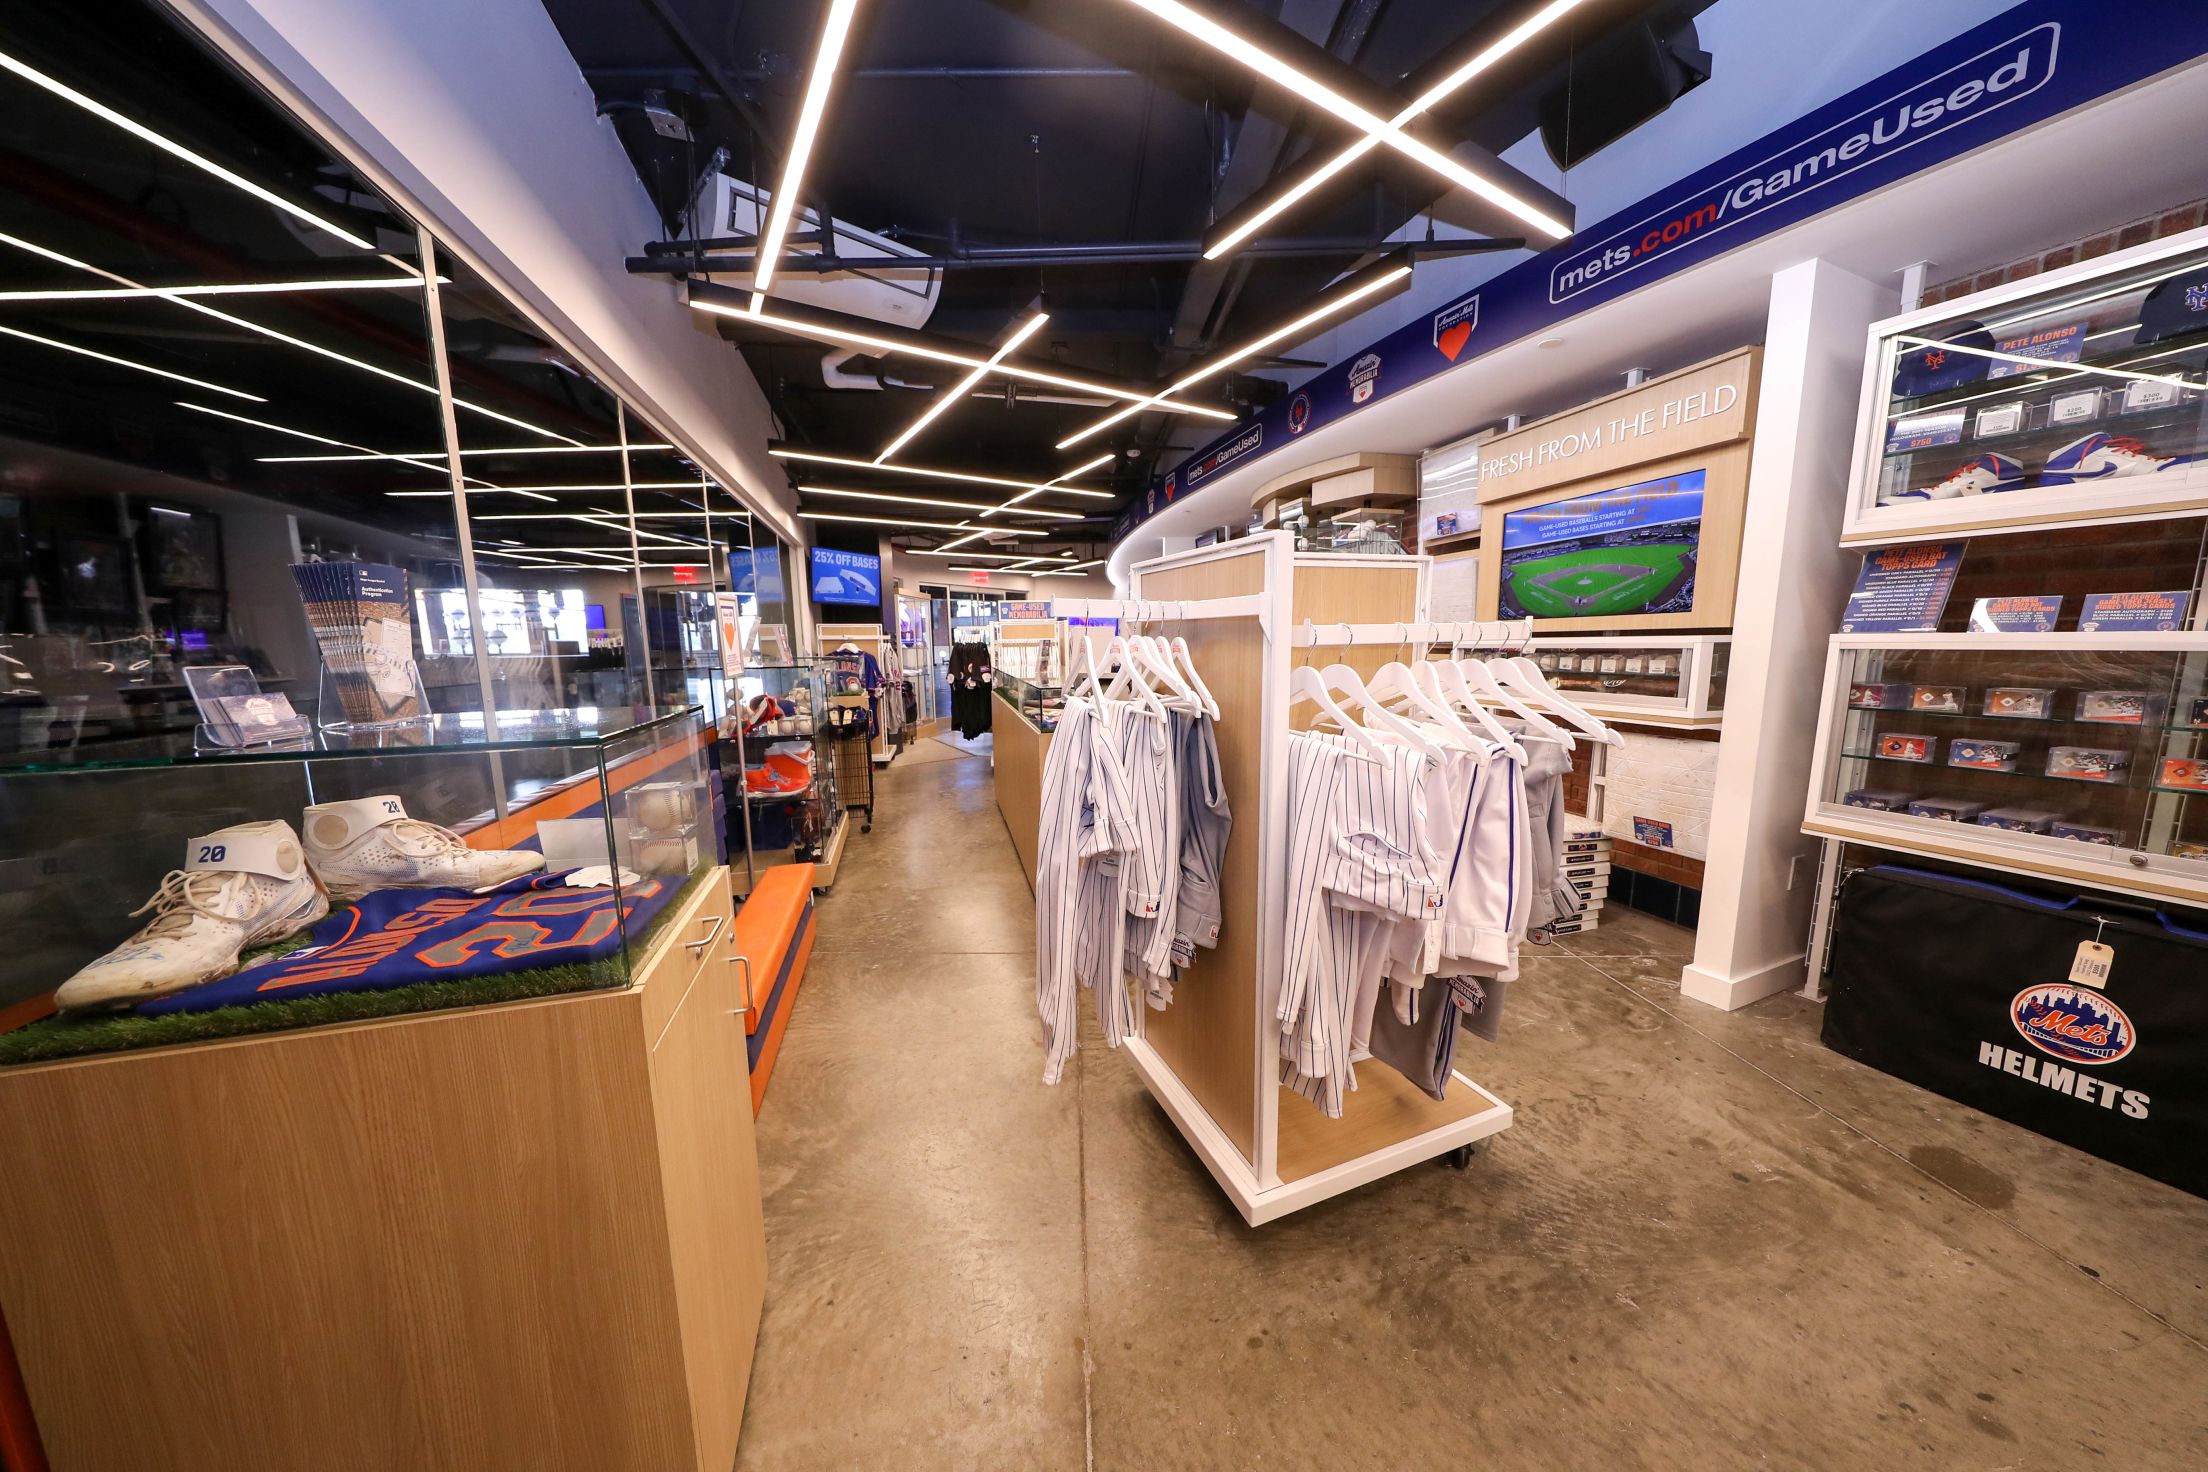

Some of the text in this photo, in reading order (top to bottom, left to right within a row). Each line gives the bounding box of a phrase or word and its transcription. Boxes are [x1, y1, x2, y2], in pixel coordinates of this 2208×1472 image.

[1559, 48, 2030, 293] mets.com/GameUsed
[2003, 326, 2077, 351] PETE ALONSO
[1481, 383, 1738, 482] FRESH FROM THE FIELD
[1539, 521, 1568, 532] GAME-USED
[1569, 515, 1598, 527] BASEBALLS
[1598, 510, 1626, 521] STARTING
[1541, 528, 1571, 538] GAME-USED
[1572, 525, 1588, 534] BASES
[1589, 520, 1617, 531] STARTING
[1617, 518, 1625, 526] AT
[815, 551, 879, 569] 25% OFF BASES
[1881, 558, 1938, 571] TOPPS CARD
[1009, 611, 1048, 619] MEMORABILIA
[198, 845, 226, 863] 20
[2030, 1009, 2112, 1046] Mets
[1978, 1040, 2150, 1120] HELMETS
